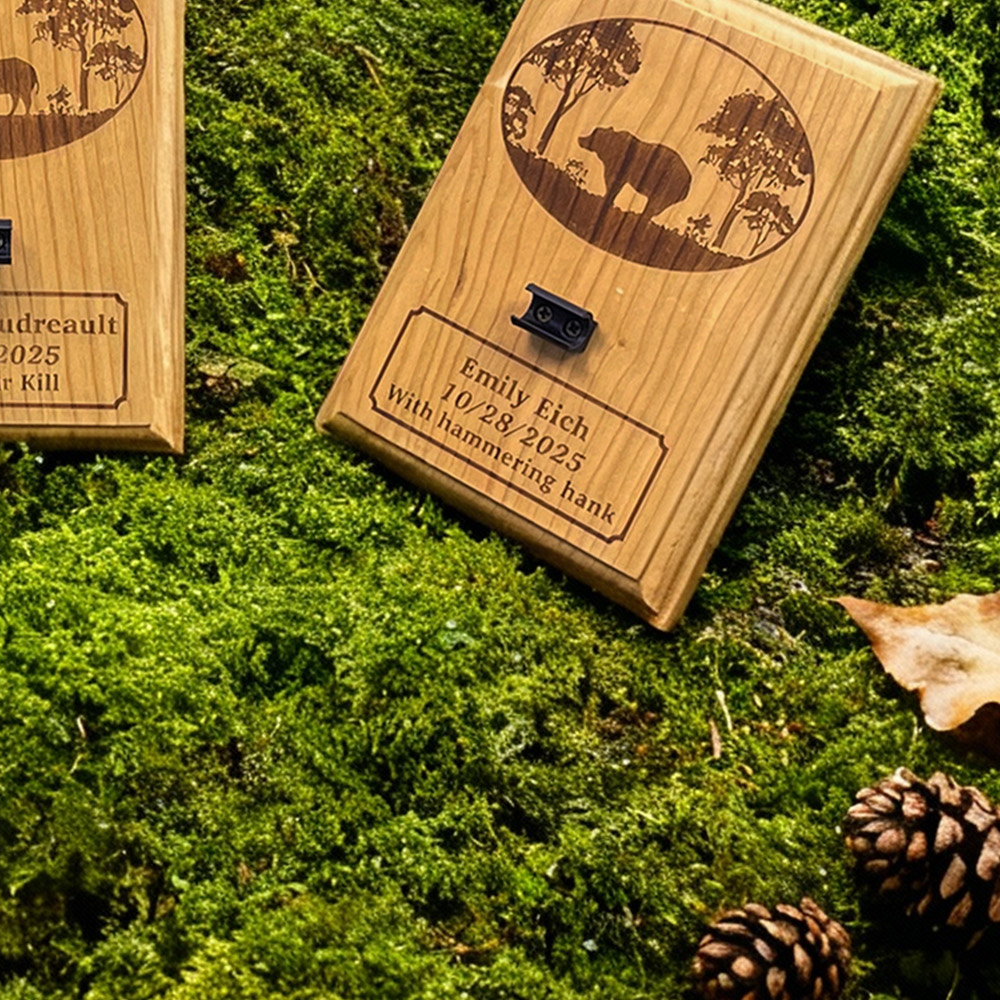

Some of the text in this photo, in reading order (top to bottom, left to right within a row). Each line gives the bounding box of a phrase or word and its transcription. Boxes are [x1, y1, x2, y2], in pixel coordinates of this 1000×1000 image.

[21, 373, 60, 392] Kill
[459, 357, 590, 442] Emily Eich
[387, 383, 617, 525] With hammering hank
[440, 383, 587, 473] 10/28/2025
